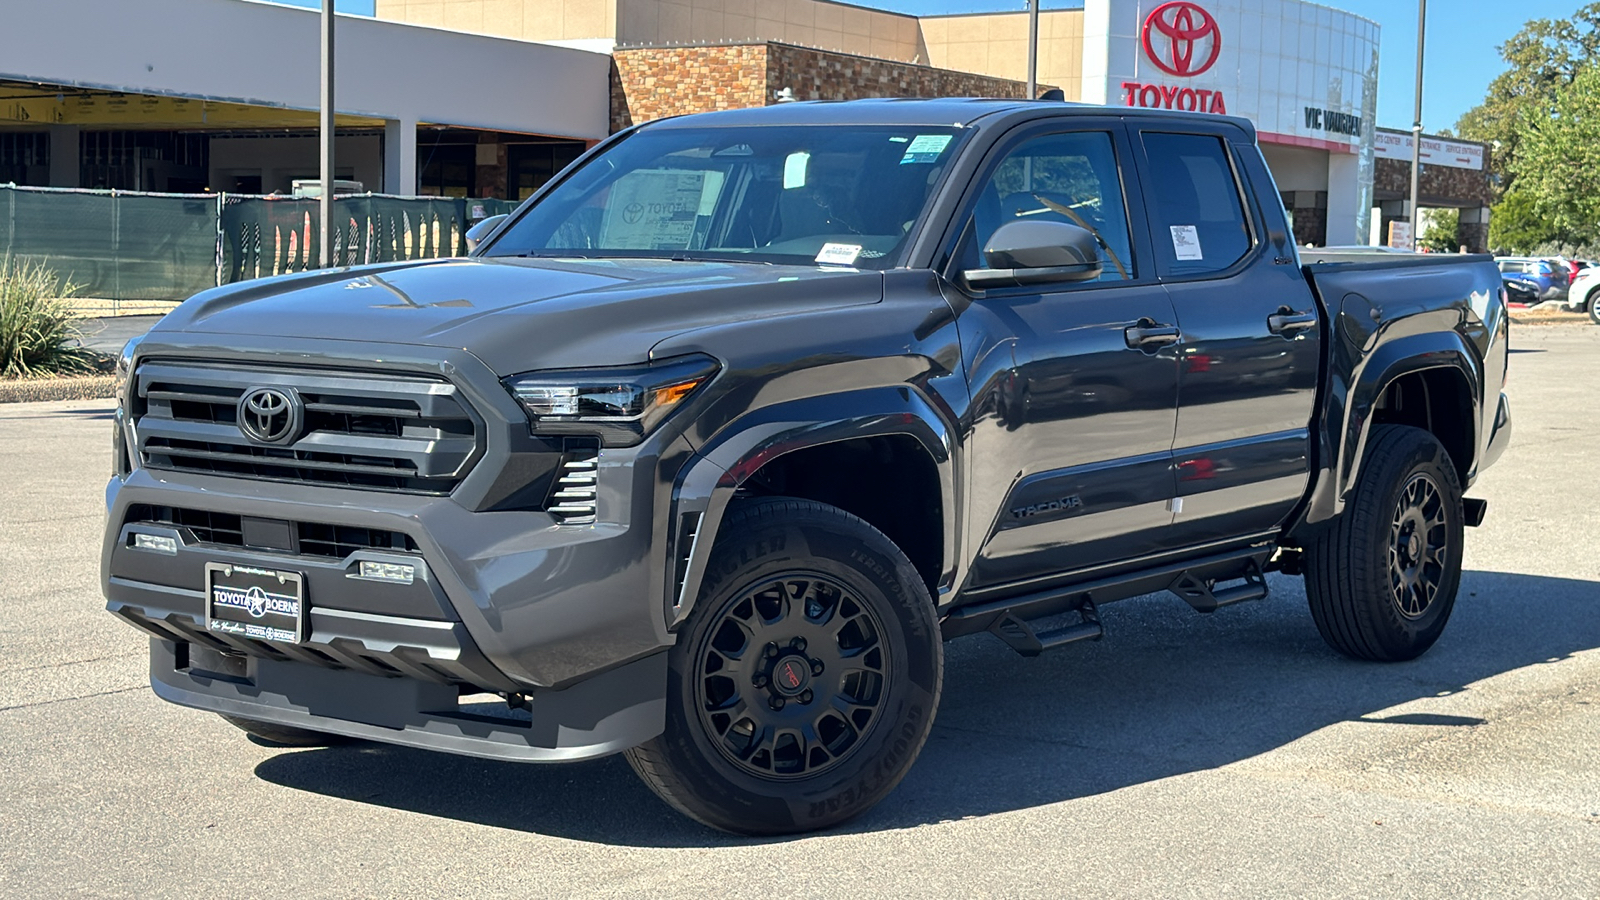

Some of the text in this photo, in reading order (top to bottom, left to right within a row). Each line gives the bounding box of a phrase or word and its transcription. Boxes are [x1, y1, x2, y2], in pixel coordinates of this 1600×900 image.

[1121, 82, 1226, 115] TOYOTA
[1304, 106, 1362, 137] VIC VAUGHAN
[1010, 495, 1083, 518] TACOMA
[213, 590, 299, 613] TOYOTA BOERNE
[784, 663, 800, 687] TRD
[808, 704, 923, 818] GOODYEAR
